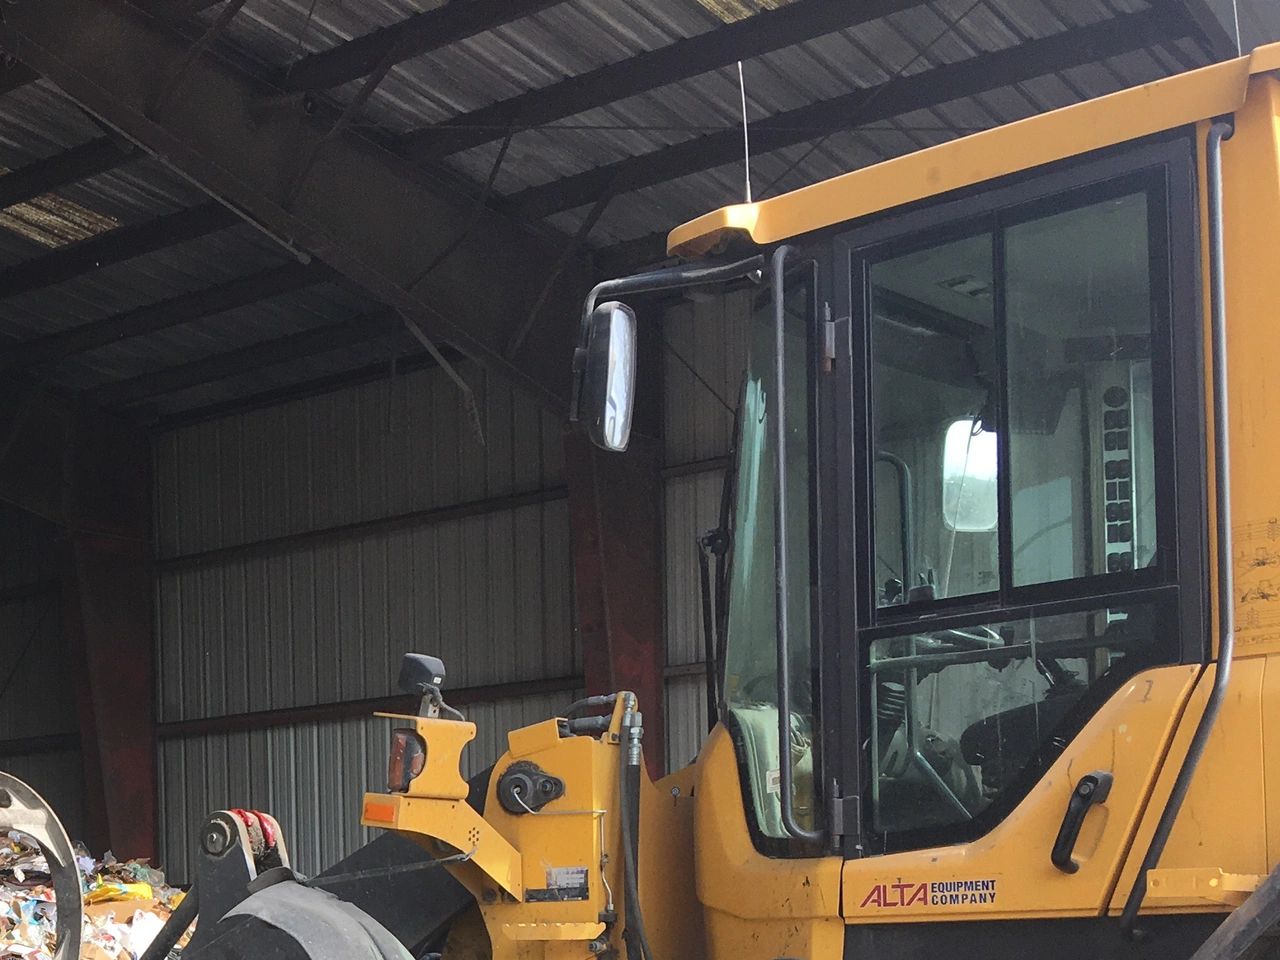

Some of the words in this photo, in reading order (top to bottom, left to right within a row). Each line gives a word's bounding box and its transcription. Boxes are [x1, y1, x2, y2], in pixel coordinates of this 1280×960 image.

[859, 882, 929, 908] ALTA
[930, 879, 997, 894] EQUIPMENT
[930, 892, 997, 906] COMPANY
